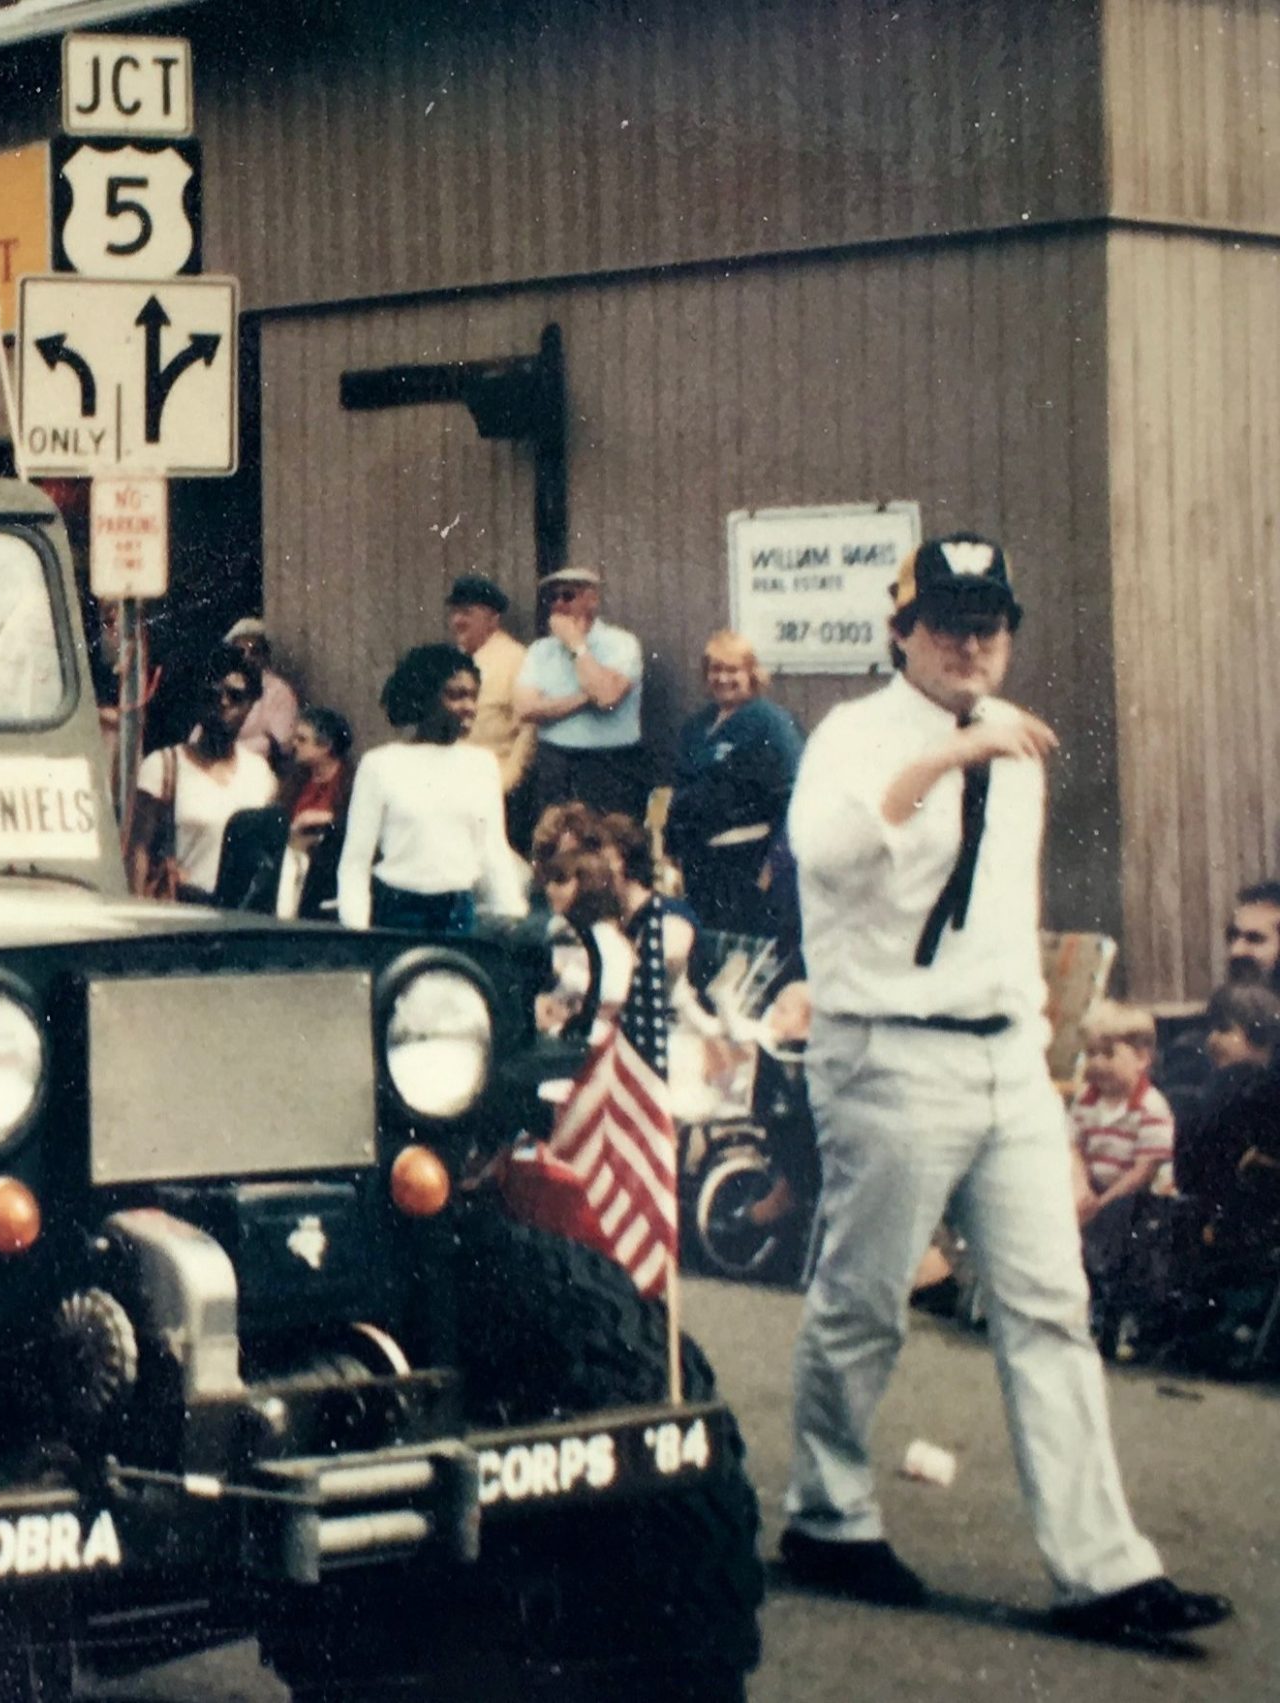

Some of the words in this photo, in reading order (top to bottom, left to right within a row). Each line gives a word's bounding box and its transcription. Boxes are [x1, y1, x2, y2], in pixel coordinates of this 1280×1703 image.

[75, 55, 179, 117] JCT
[105, 177, 152, 256] 5
[29, 426, 106, 455] ONLY
[752, 544, 831, 571] WILLIAM
[752, 574, 785, 594] REAL
[477, 1432, 617, 1504] CORPS
